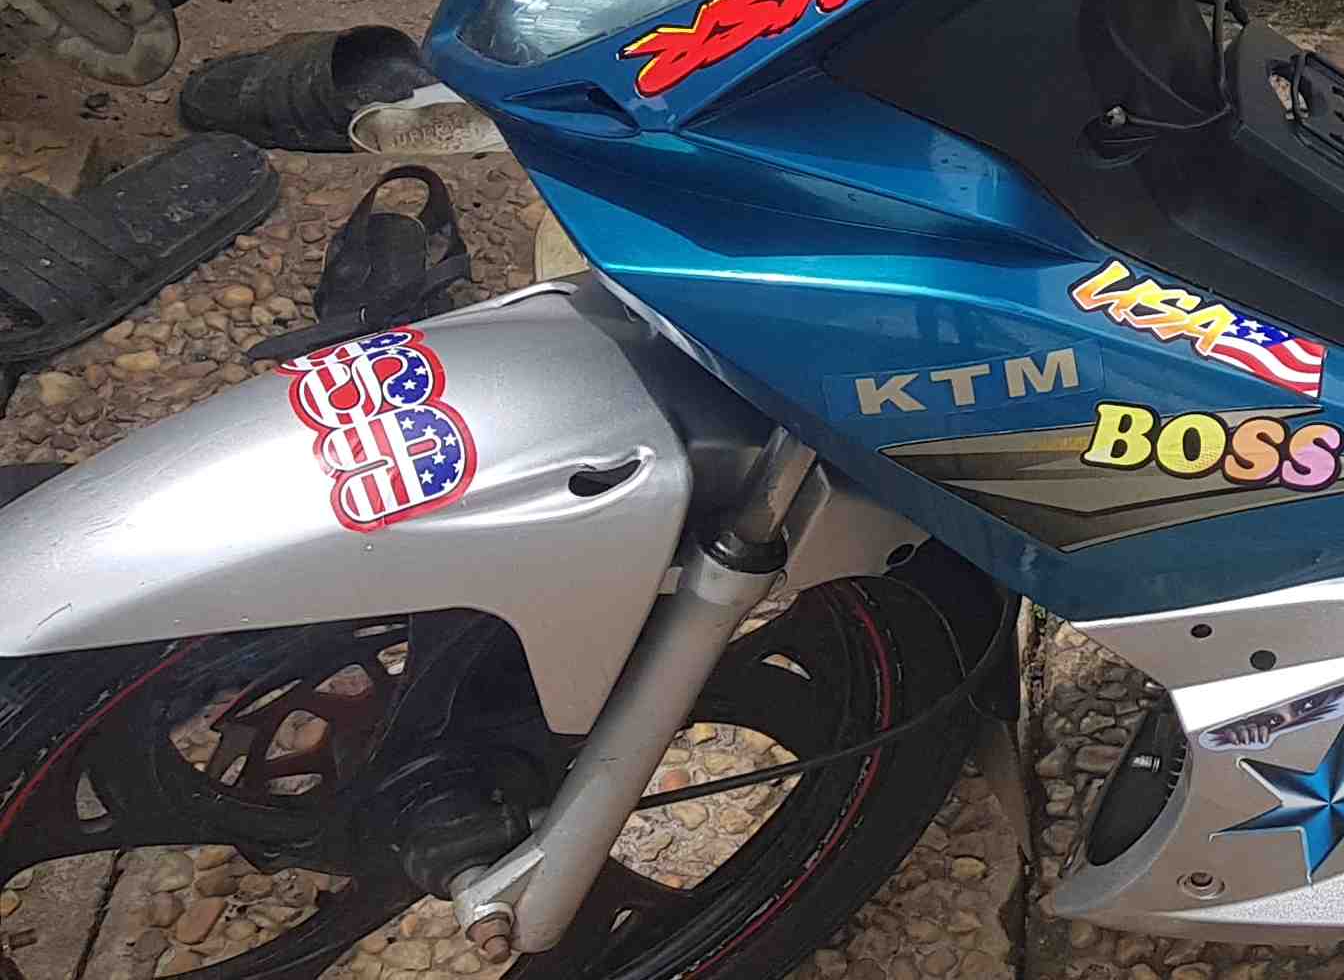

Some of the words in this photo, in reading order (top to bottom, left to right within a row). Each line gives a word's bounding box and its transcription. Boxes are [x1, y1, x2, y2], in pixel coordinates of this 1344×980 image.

[1071, 259, 1238, 356] USA
[855, 347, 1080, 416] KTM
[1082, 402, 1344, 490] BOSS
